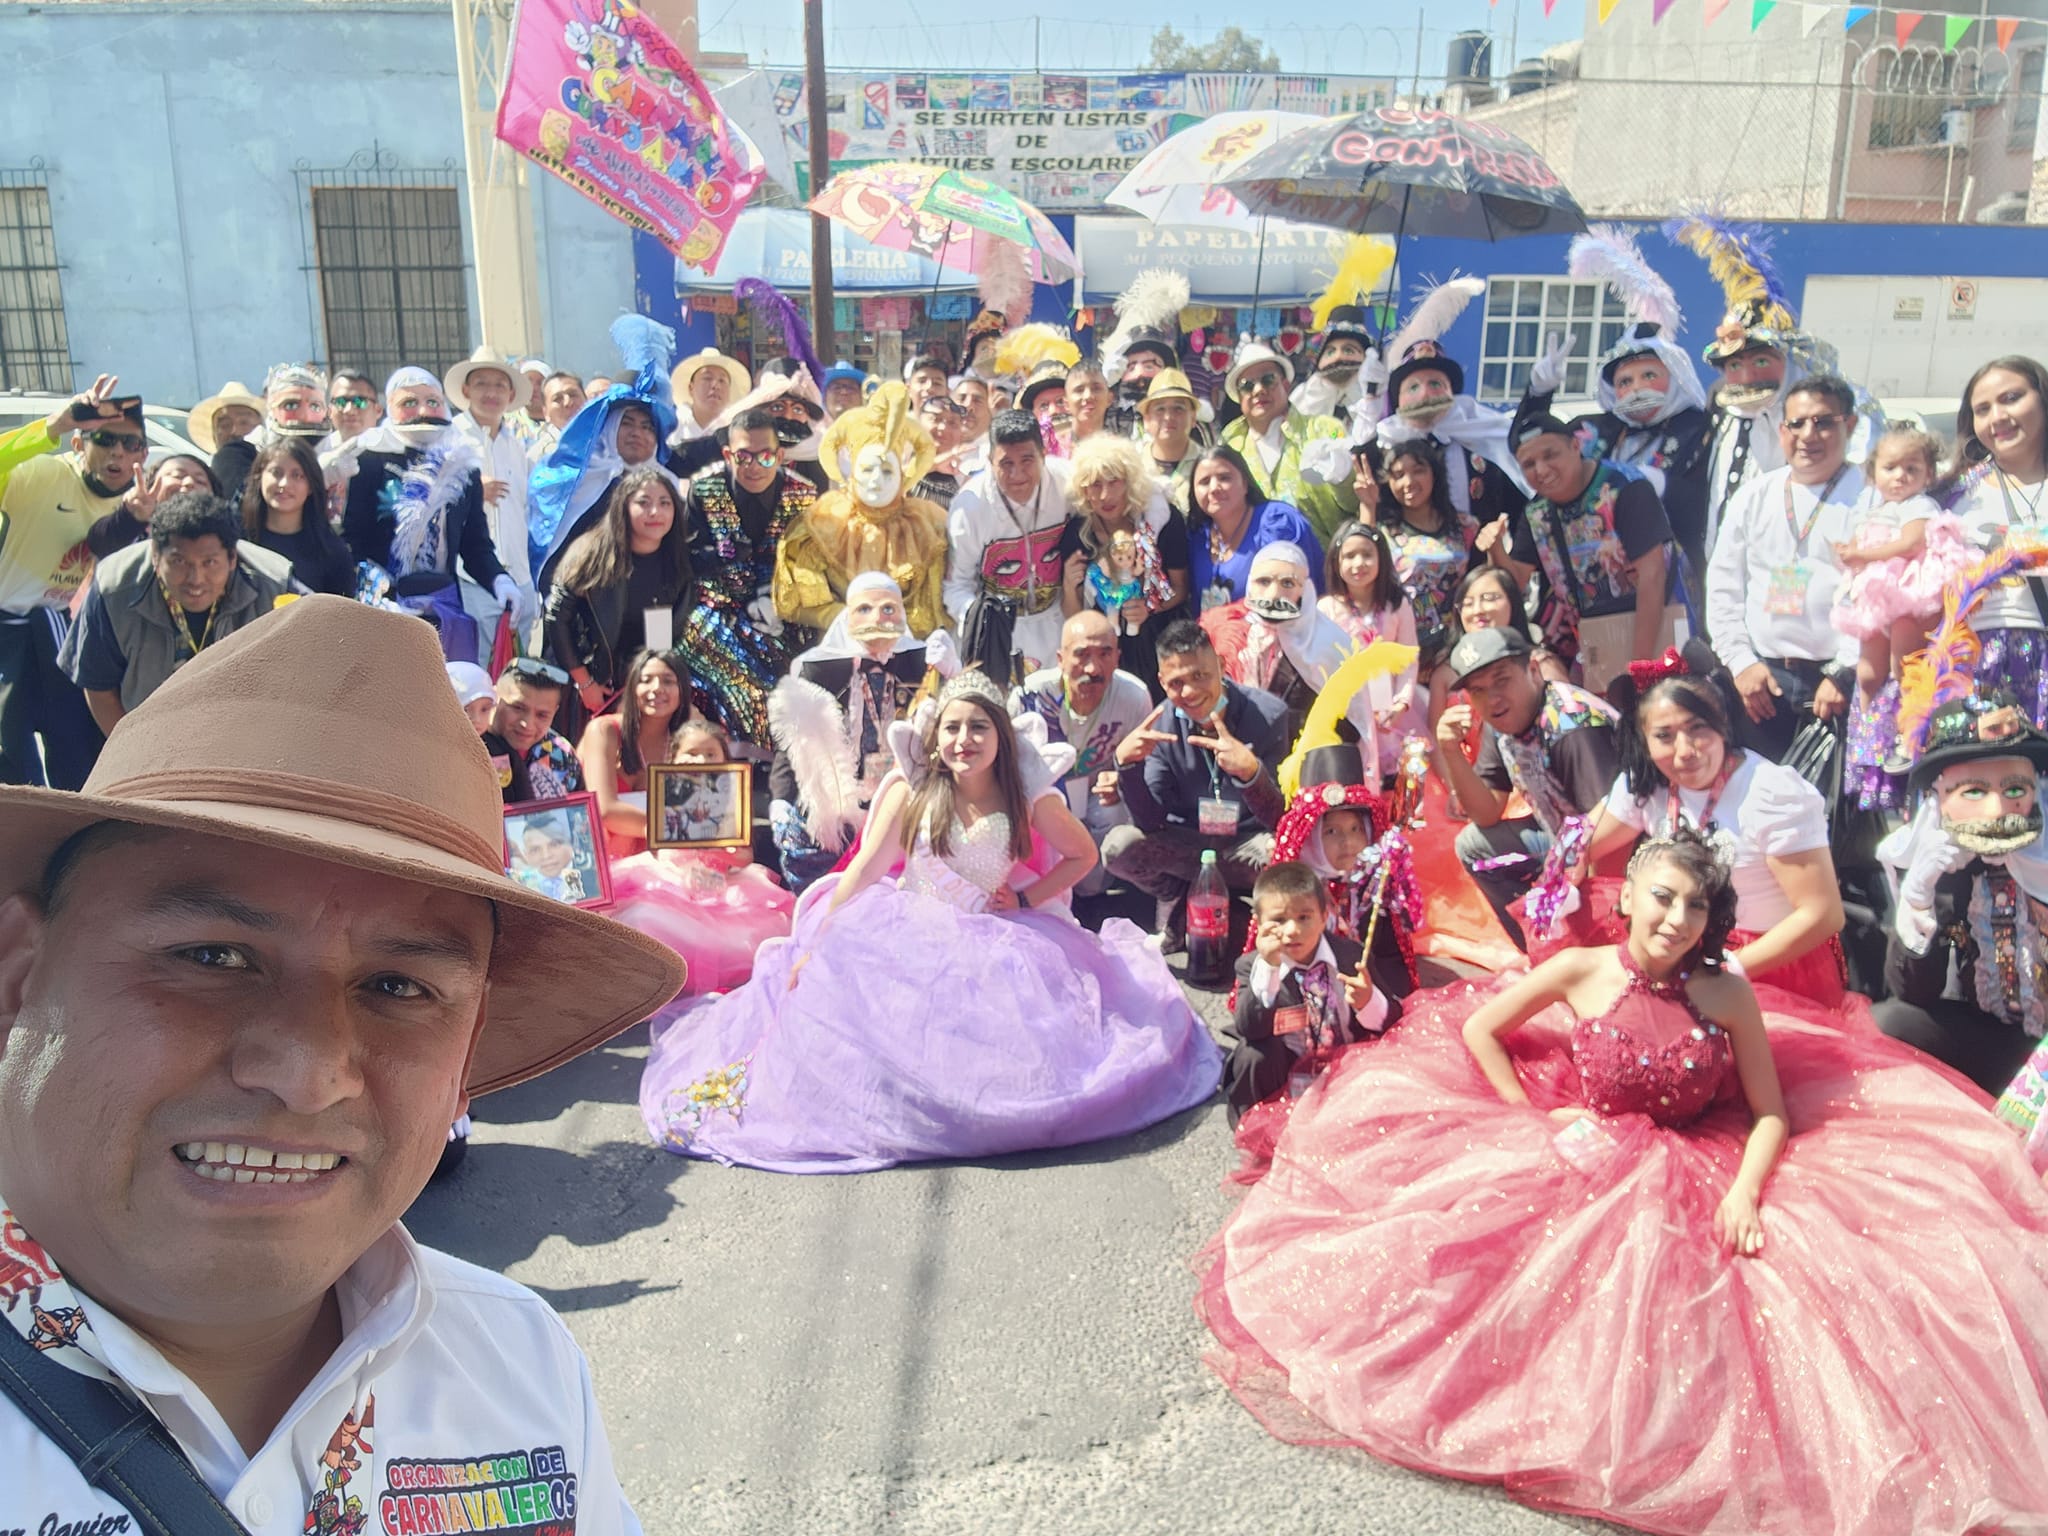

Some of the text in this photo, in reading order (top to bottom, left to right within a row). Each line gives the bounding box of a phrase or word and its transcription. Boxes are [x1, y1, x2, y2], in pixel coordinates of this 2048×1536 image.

[914, 111, 1148, 127] SE SURTEN LISTAS
[1016, 135, 1048, 148] DE
[1010, 157, 1143, 171] ESCOLARE
[1136, 229, 1346, 249] PAPELERIA
[780, 248, 907, 269] PAELERIA
[389, 1451, 564, 1490] ORGANIZACION DE
[380, 1478, 577, 1536] CARNAVALEROS
